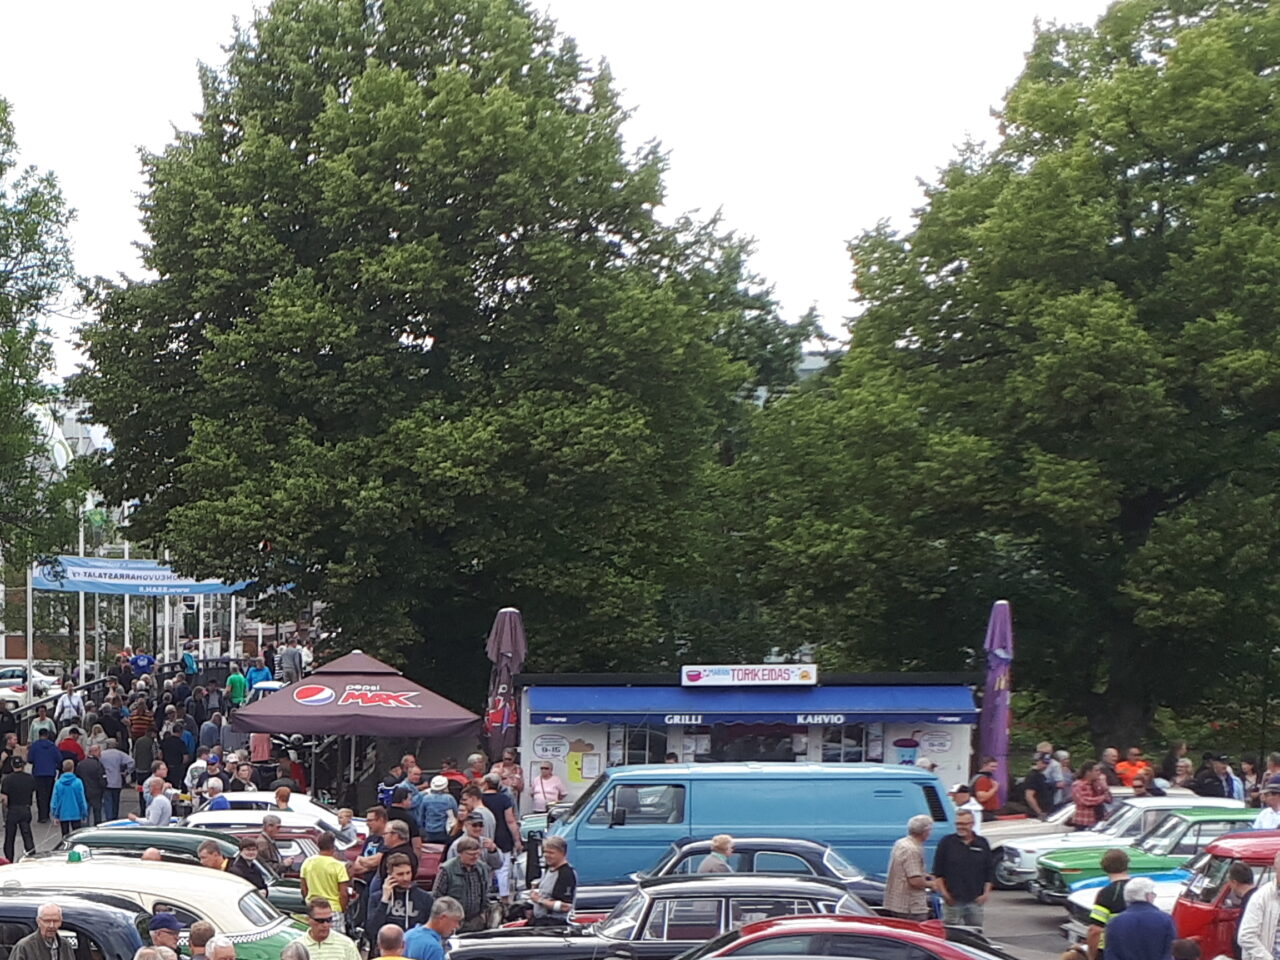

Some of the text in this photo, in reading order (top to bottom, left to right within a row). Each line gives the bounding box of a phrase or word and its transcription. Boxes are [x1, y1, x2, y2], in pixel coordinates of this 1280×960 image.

[731, 668, 791, 681] TORIKEIDAS
[337, 690, 420, 708] MAX
[664, 714, 703, 724] GRILLI
[796, 714, 845, 724] KAHVIO
